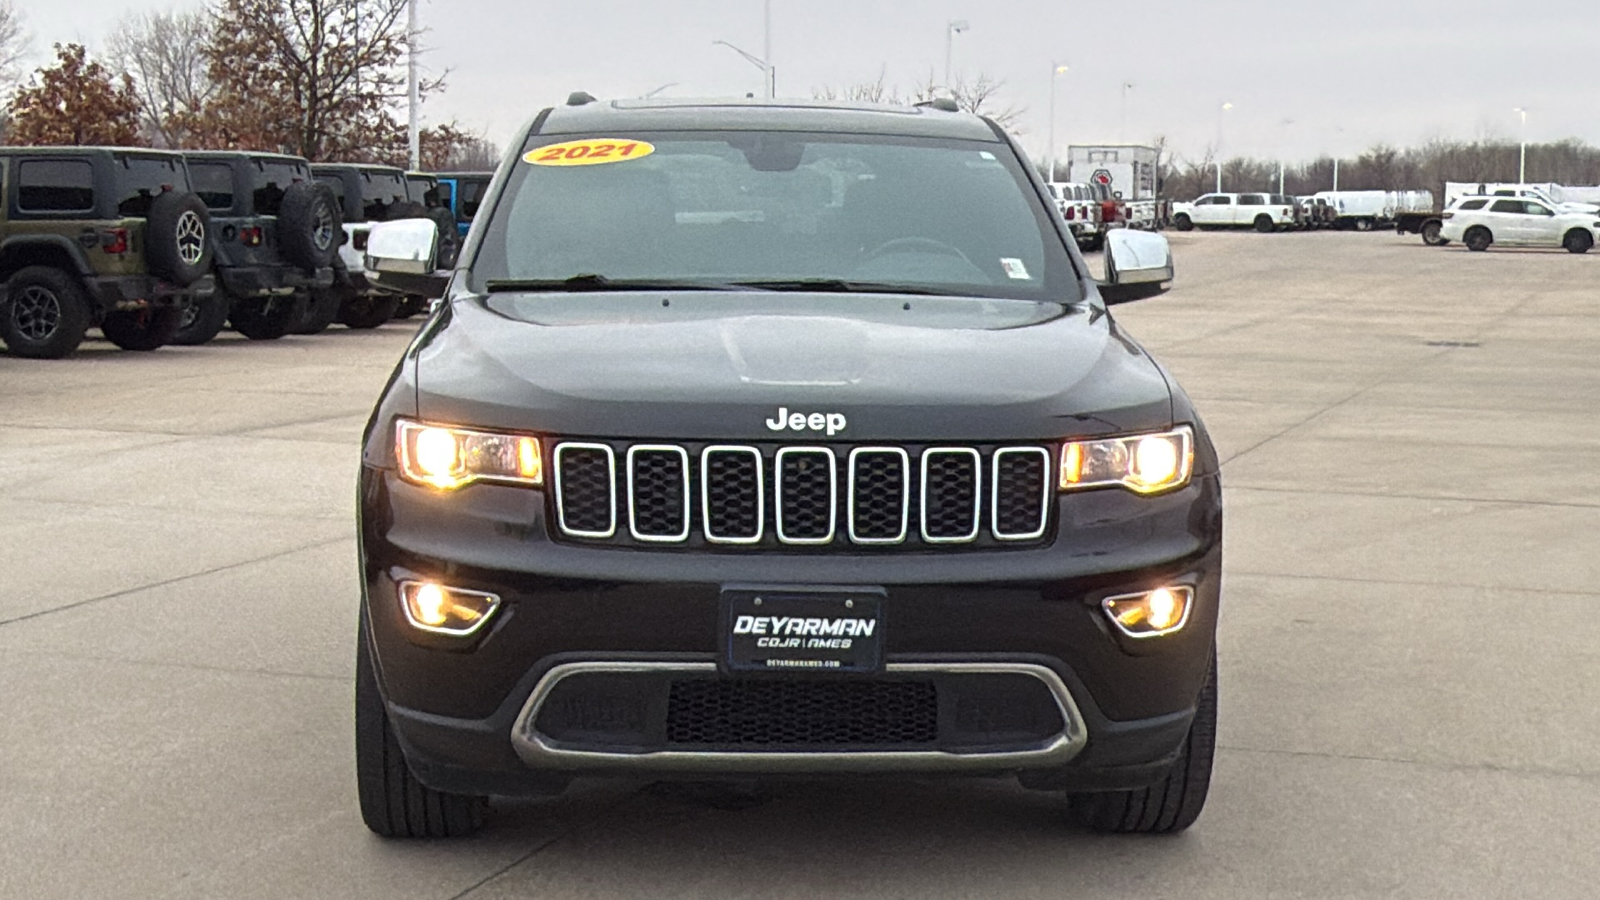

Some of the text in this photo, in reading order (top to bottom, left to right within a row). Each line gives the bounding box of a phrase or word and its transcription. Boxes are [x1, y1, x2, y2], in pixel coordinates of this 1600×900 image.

[537, 143, 638, 161] 2021
[766, 407, 847, 436] Jeep
[733, 615, 876, 636] DEYARMAN
[807, 638, 853, 649] AMES
